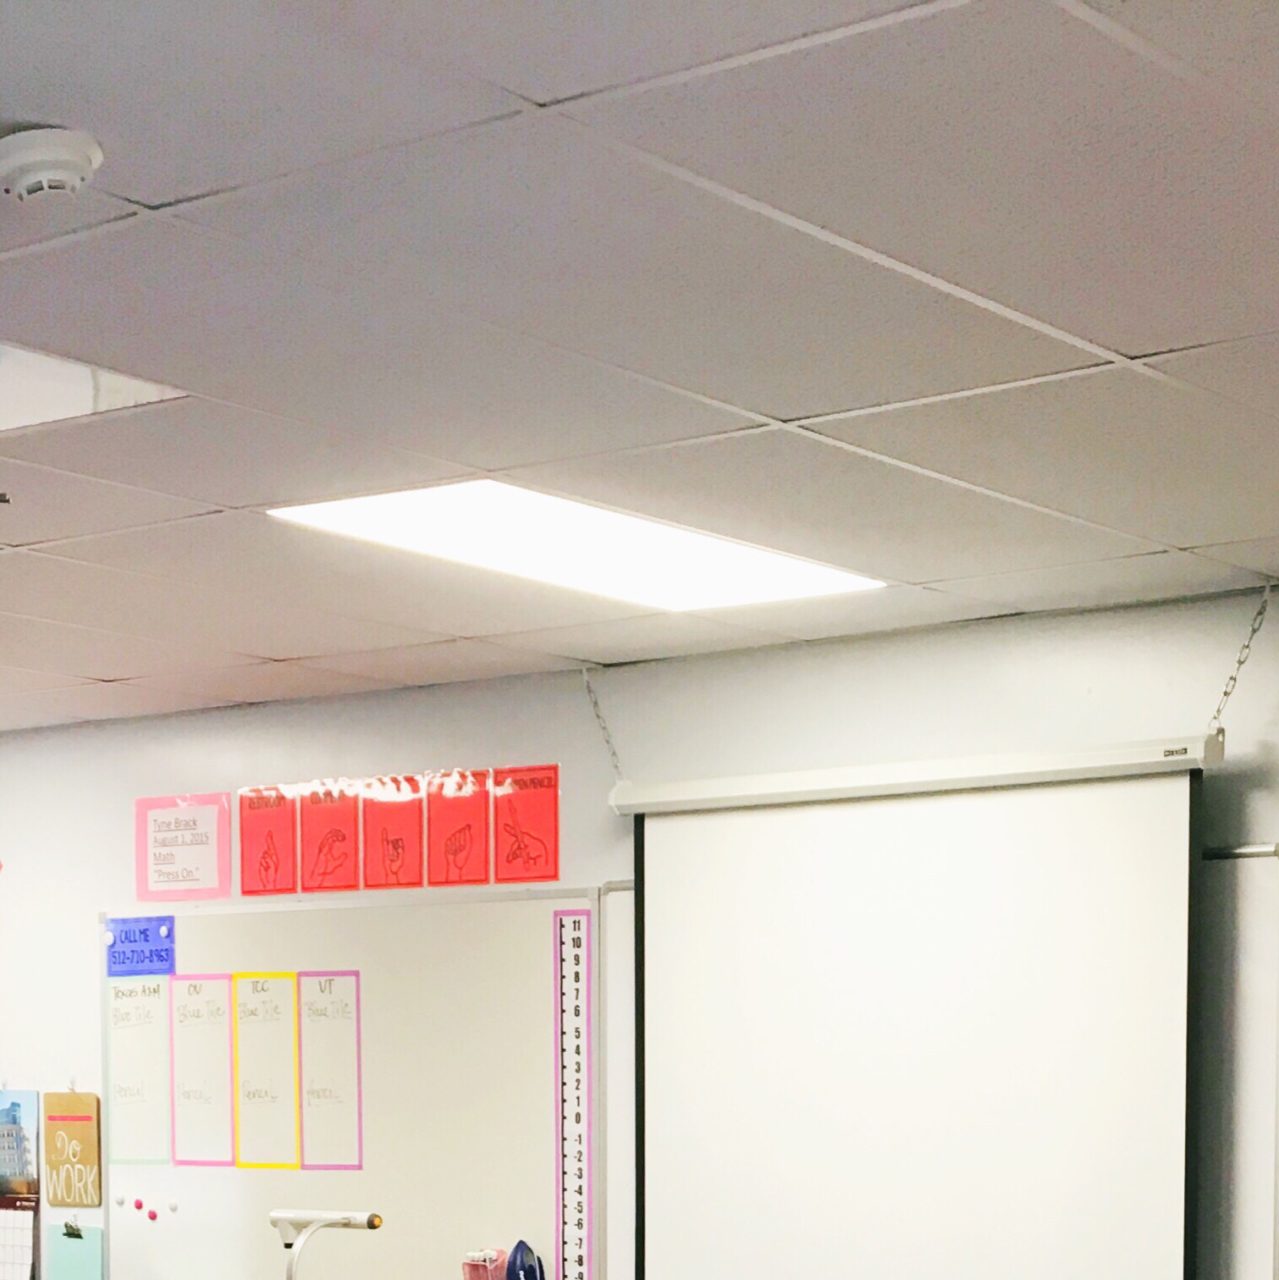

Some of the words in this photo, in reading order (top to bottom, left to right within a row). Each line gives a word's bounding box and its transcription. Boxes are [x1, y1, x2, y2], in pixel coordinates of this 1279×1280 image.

[573, 920, 580, 931] 11
[120, 929, 138, 943] CALL
[140, 928, 150, 943] ME
[572, 937, 581, 948] 10
[574, 954, 580, 966] 9
[574, 971, 580, 983] 8
[574, 988, 580, 1000] 7
[574, 1005, 580, 1017] 6
[575, 1027, 580, 1039] 5
[575, 1044, 580, 1055] 4
[575, 1061, 580, 1073] 3
[575, 1079, 580, 1090] 2
[576, 1096, 580, 1107] 1
[575, 1112, 581, 1124] 0
[52, 1131, 81, 1162] Do
[46, 1164, 99, 1205] WORK
